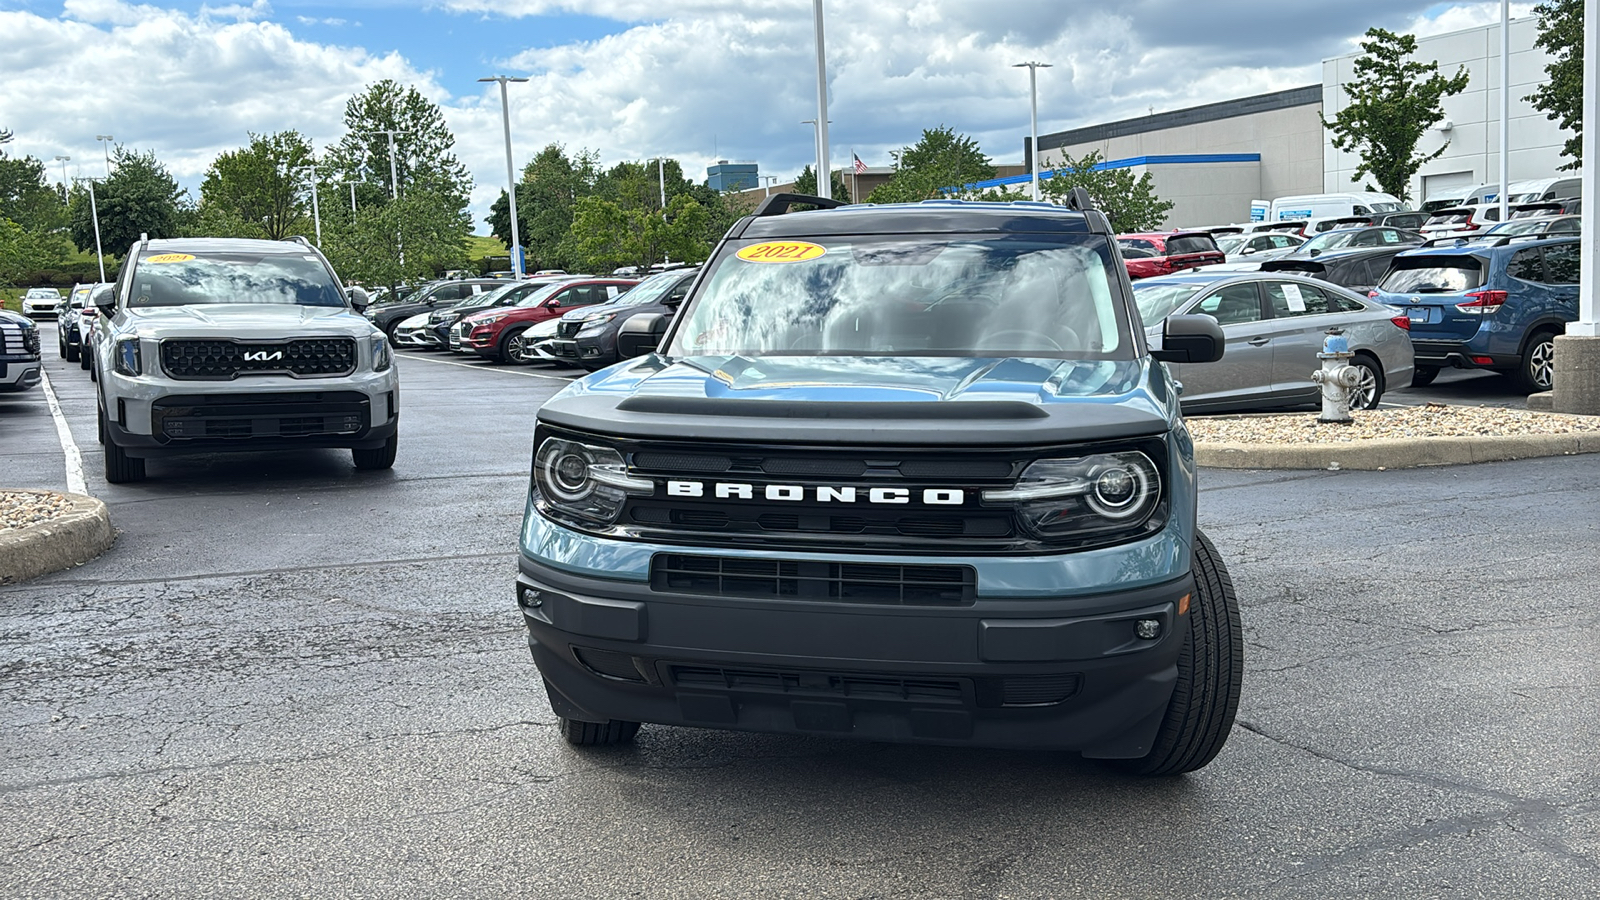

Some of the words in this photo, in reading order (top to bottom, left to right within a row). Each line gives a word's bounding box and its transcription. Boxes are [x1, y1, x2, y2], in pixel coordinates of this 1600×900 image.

[153, 254, 188, 262] 2024
[747, 245, 814, 259] 2021
[243, 351, 282, 361] KIA
[667, 480, 964, 505] BRONCO
